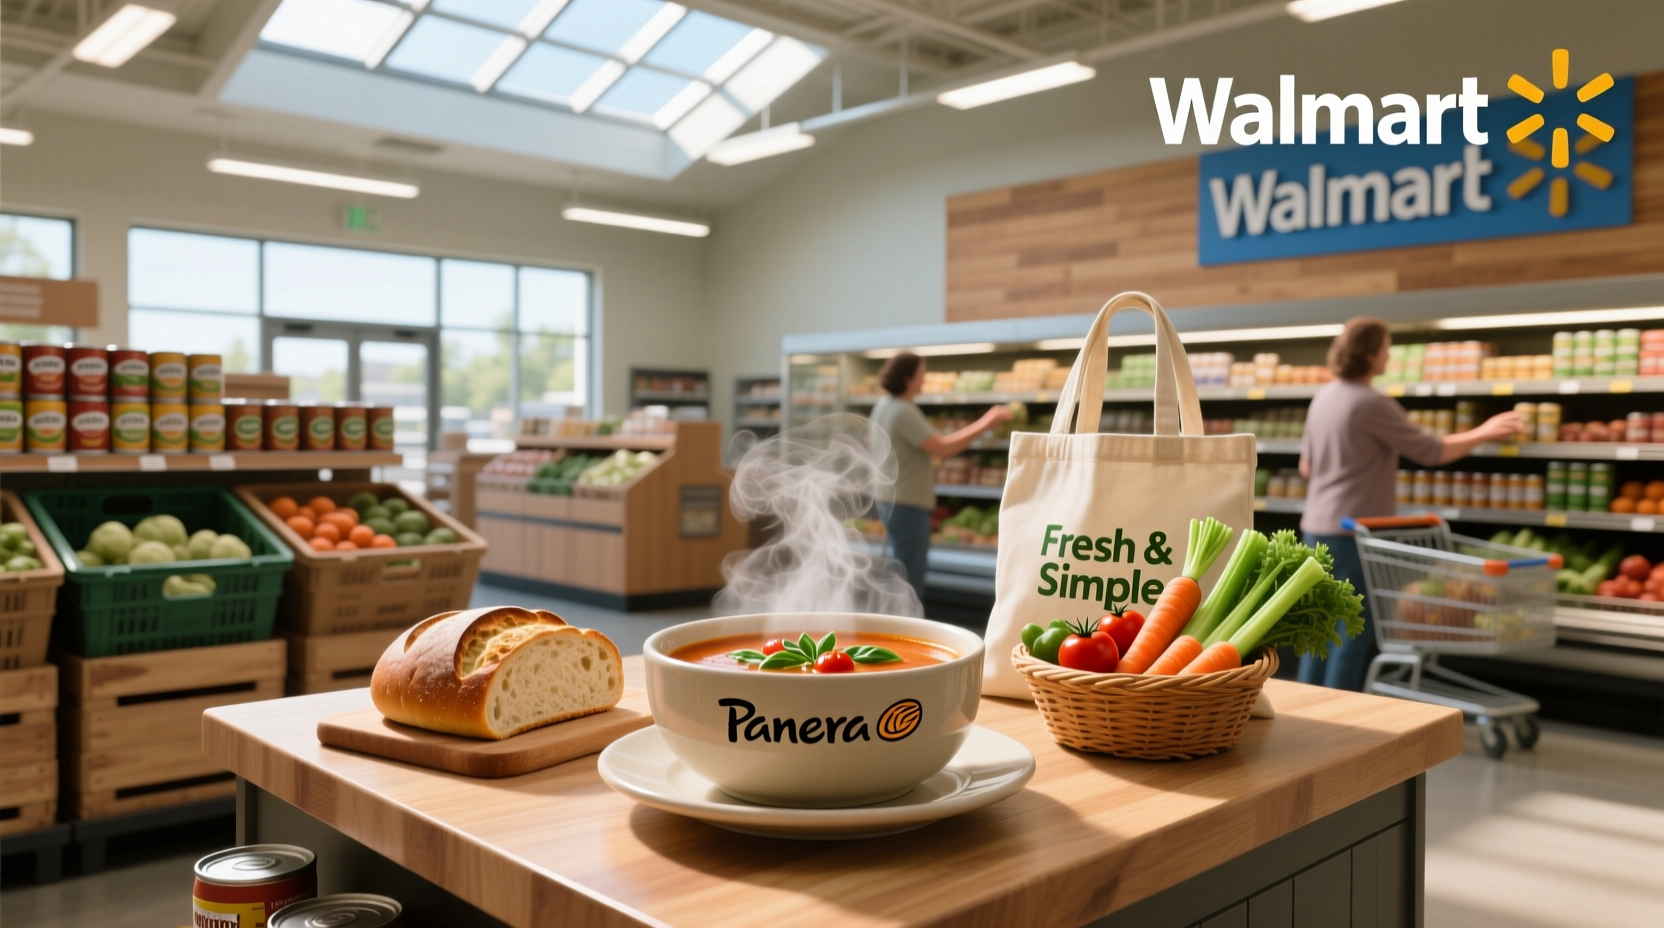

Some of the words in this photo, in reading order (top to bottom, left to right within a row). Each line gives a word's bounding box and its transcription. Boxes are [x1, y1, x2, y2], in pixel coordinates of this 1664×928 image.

[1210, 146, 1491, 238] Walmart
[1041, 524, 1136, 563] Fresh
[1143, 531, 1173, 565] &
[1037, 562, 1165, 611] Simple
[718, 698, 870, 744] Panera
